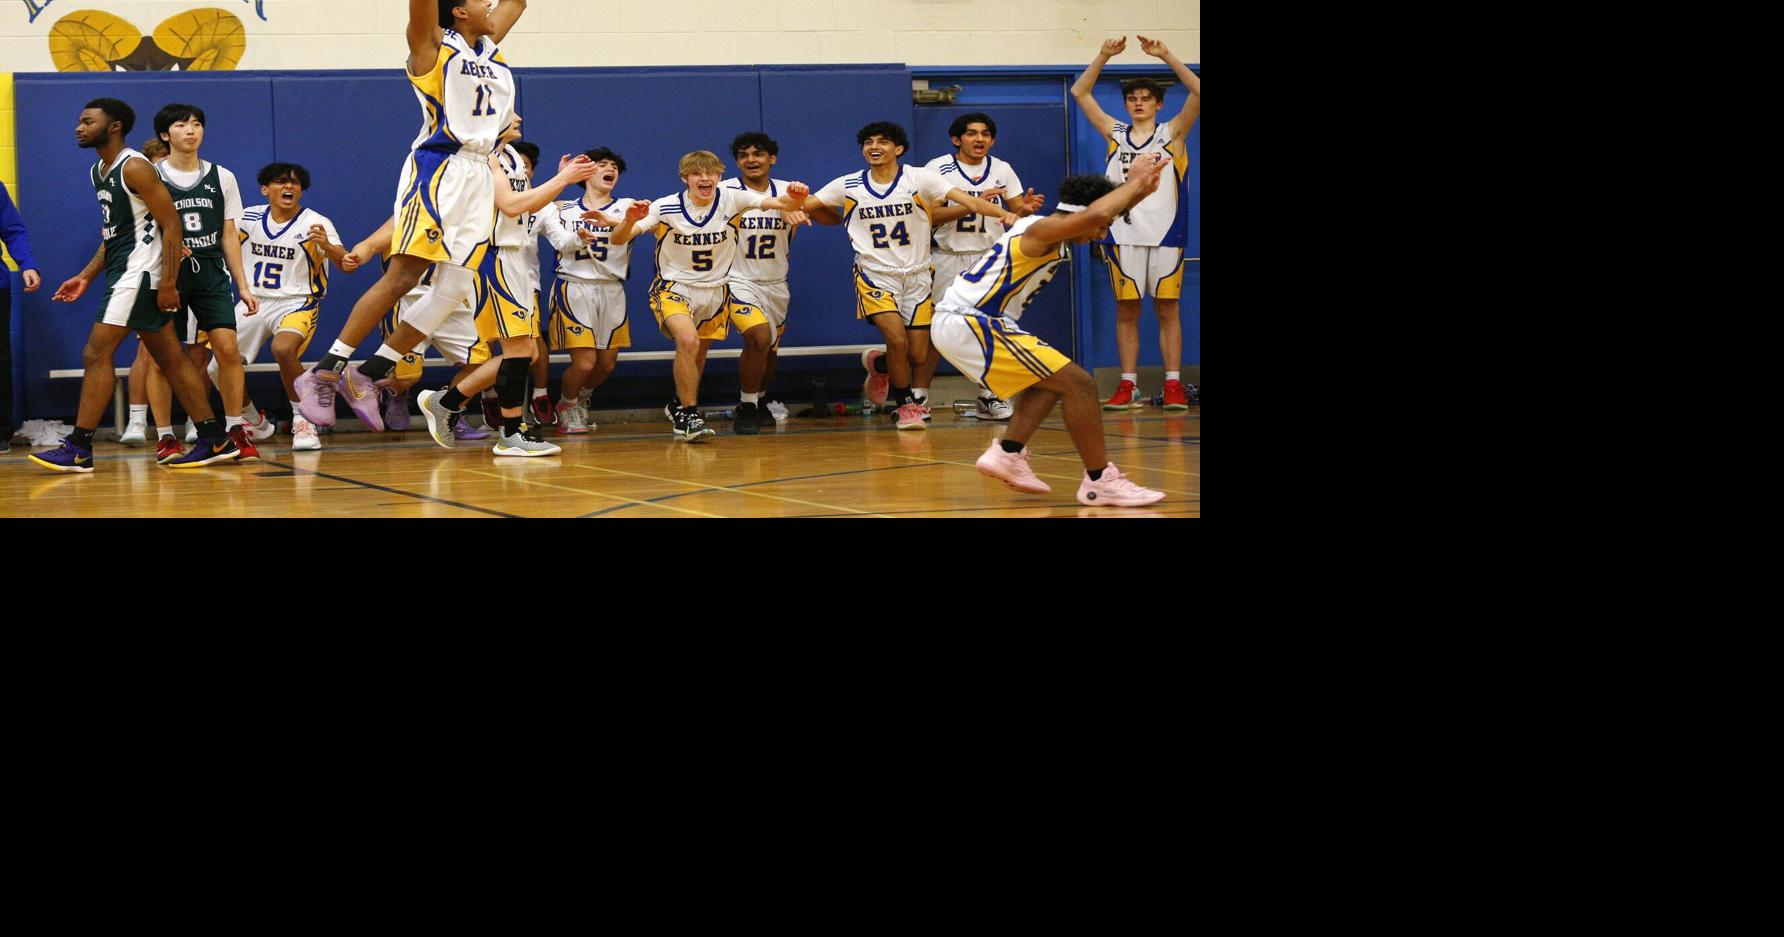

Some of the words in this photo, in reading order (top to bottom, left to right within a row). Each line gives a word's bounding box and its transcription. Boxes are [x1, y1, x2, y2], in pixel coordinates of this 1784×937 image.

[472, 84, 496, 116] 11
[184, 212, 203, 231] 8
[859, 203, 913, 220] KENNER
[673, 230, 728, 246] KENNER
[870, 221, 911, 249] 24
[251, 242, 296, 260] KENNER
[745, 235, 776, 259] 12
[692, 250, 713, 272] 5
[253, 262, 283, 290] 15
